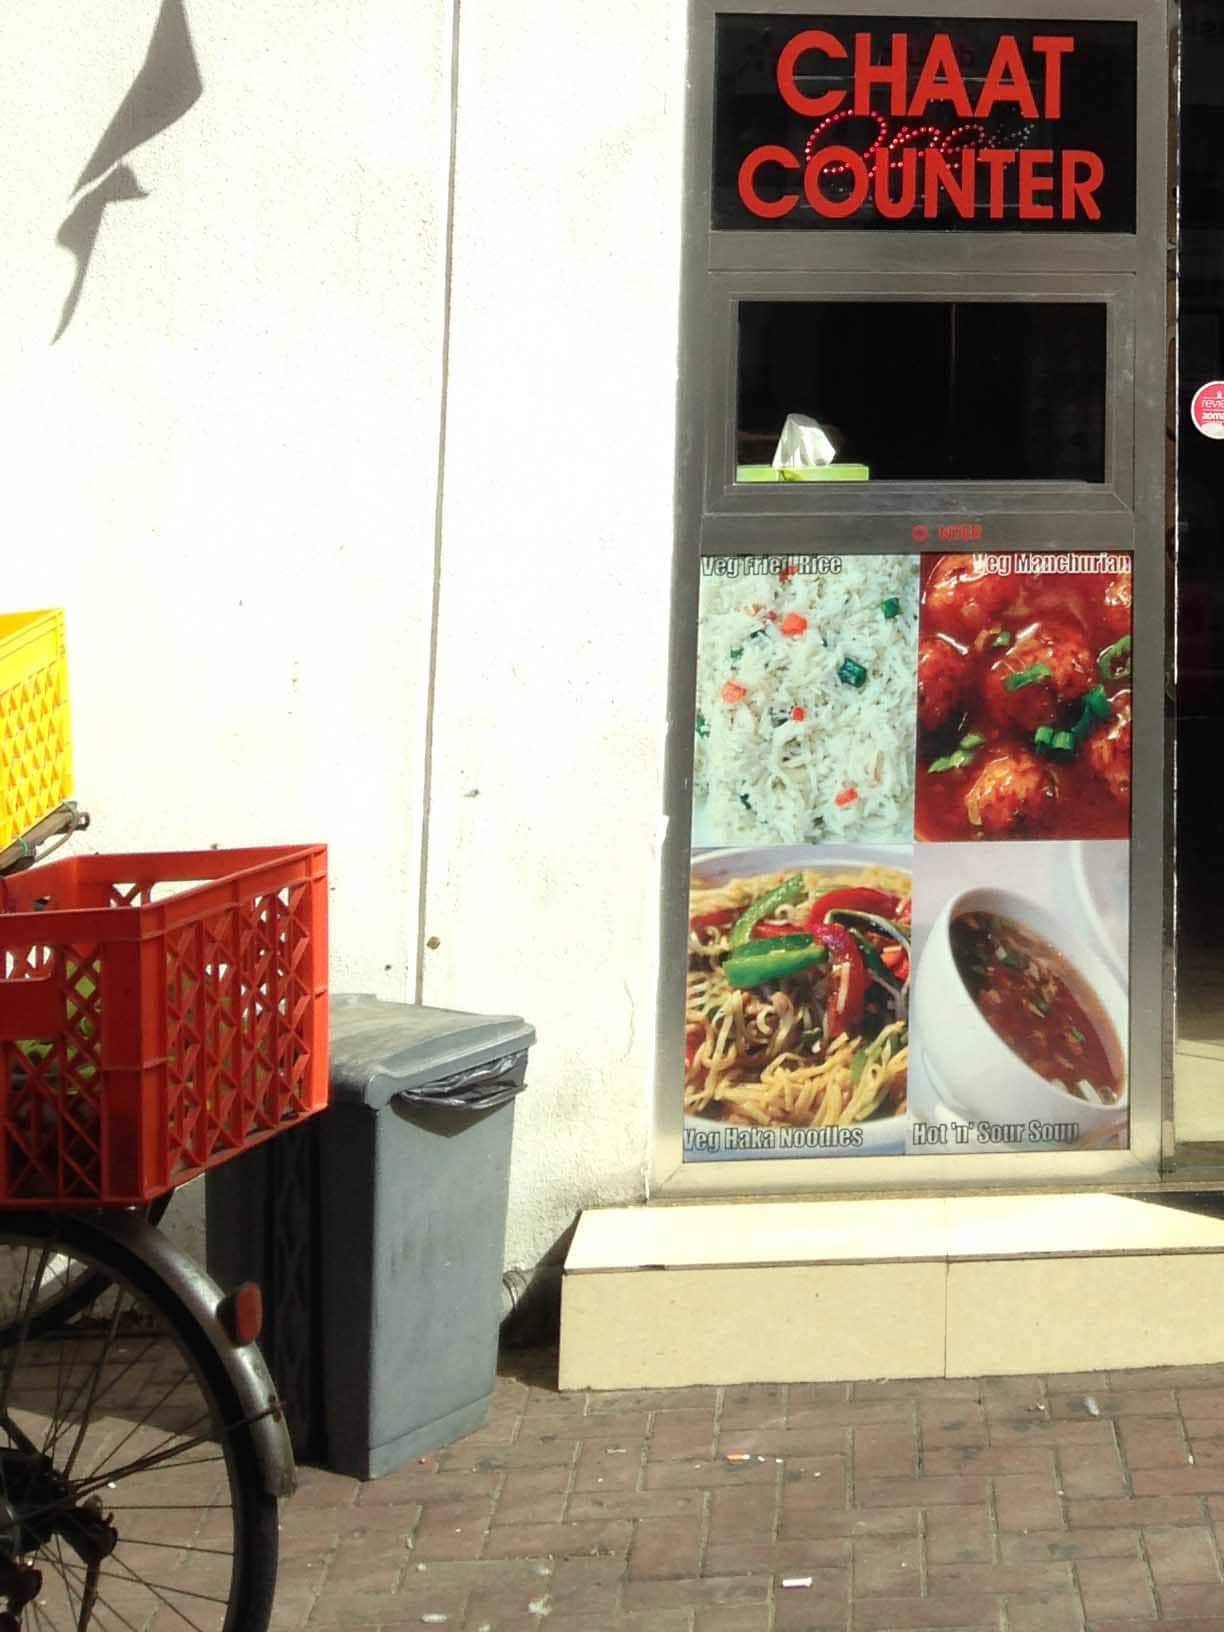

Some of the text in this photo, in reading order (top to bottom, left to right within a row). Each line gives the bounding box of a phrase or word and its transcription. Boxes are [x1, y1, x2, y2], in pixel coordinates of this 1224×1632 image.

[776, 29, 1075, 119] CHAAT
[737, 144, 1105, 221] COUNTER
[701, 556, 741, 578] Veg
[799, 555, 843, 574] Rice
[972, 553, 1131, 576] Veg Manchurian
[683, 1125, 863, 1153] Veg Haka Noodles
[912, 1122, 948, 1146] Hot
[977, 1120, 1026, 1144] Sour
[1028, 1119, 1080, 1144] Soup
